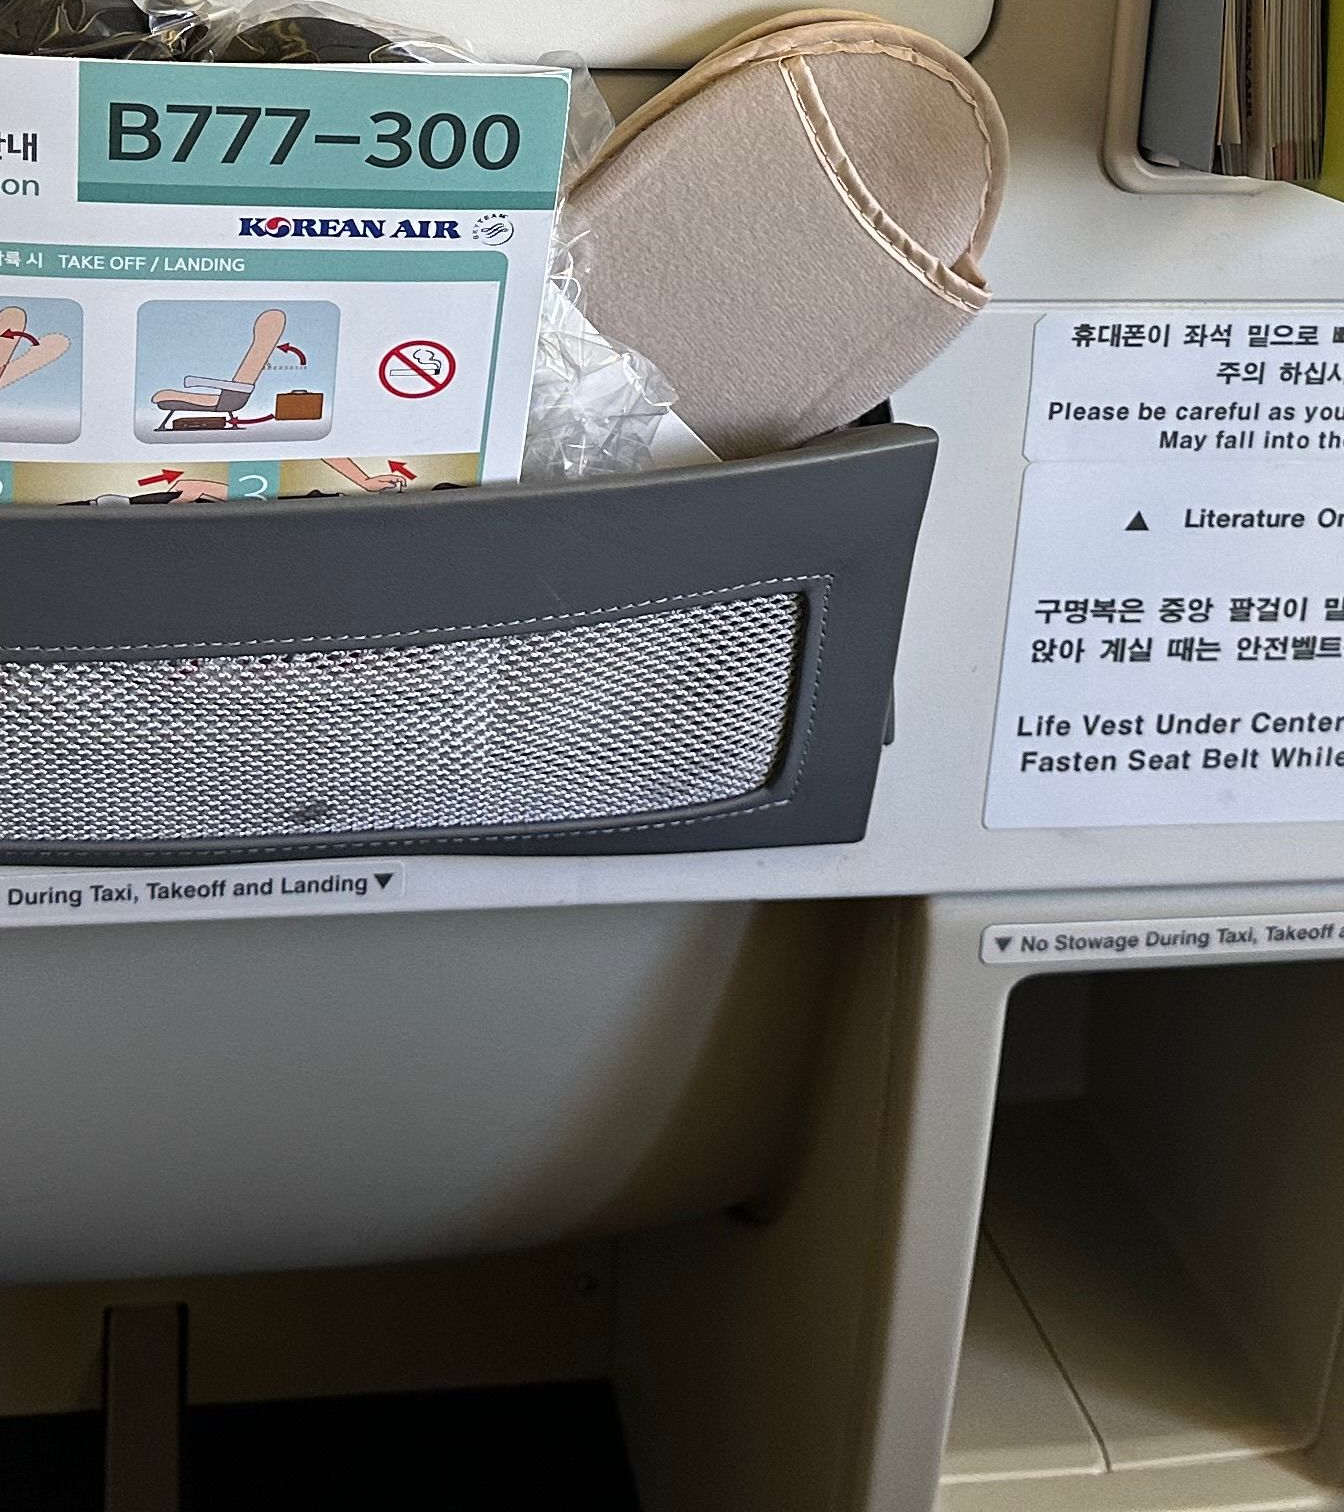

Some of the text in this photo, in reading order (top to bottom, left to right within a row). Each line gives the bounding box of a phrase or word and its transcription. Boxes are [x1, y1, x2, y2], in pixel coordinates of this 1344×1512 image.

[108, 101, 521, 171] B777-300
[238, 217, 461, 239] KOREAN AIR
[26, 252, 43, 268] 시
[58, 254, 104, 270] TAKE
[110, 256, 146, 270] OFF
[164, 258, 245, 272] LANDING
[1072, 323, 1169, 348] 휴대폰이
[1184, 324, 1232, 347] 좌석
[1247, 324, 1319, 347] 밑으로
[1216, 362, 1265, 385] 주의
[1048, 402, 1129, 421] Please
[1138, 403, 1166, 421] be
[1175, 402, 1259, 421] careful
[1268, 406, 1295, 421] as
[1159, 431, 1207, 452] May
[1215, 431, 1255, 449] fall
[1264, 431, 1310, 449] into
[1184, 509, 1305, 528] Literature
[1034, 598, 1145, 624] 구명복은
[1158, 598, 1213, 623] 중앙
[1229, 597, 1308, 622] 팔걸이
[1031, 638, 1086, 665] 앉아
[1100, 638, 1154, 663] 계실
[1168, 638, 1221, 663] 때는
[1017, 715, 1071, 737] Life
[1083, 714, 1144, 736] Vest
[1156, 714, 1241, 736] Under
[1020, 751, 1117, 773] Fasten
[1128, 750, 1192, 771] Seat
[1202, 749, 1258, 770] Belt
[8, 886, 82, 909] During
[89, 882, 139, 906] Taxi,
[146, 879, 225, 900] Takeoff
[233, 878, 273, 897] and
[281, 874, 368, 896] Landing
[1021, 935, 1049, 953] No
[1056, 932, 1139, 953] Stowage
[1146, 930, 1210, 949] During
[1217, 927, 1259, 945] Taxi,
[1265, 922, 1333, 942] Takeoff
